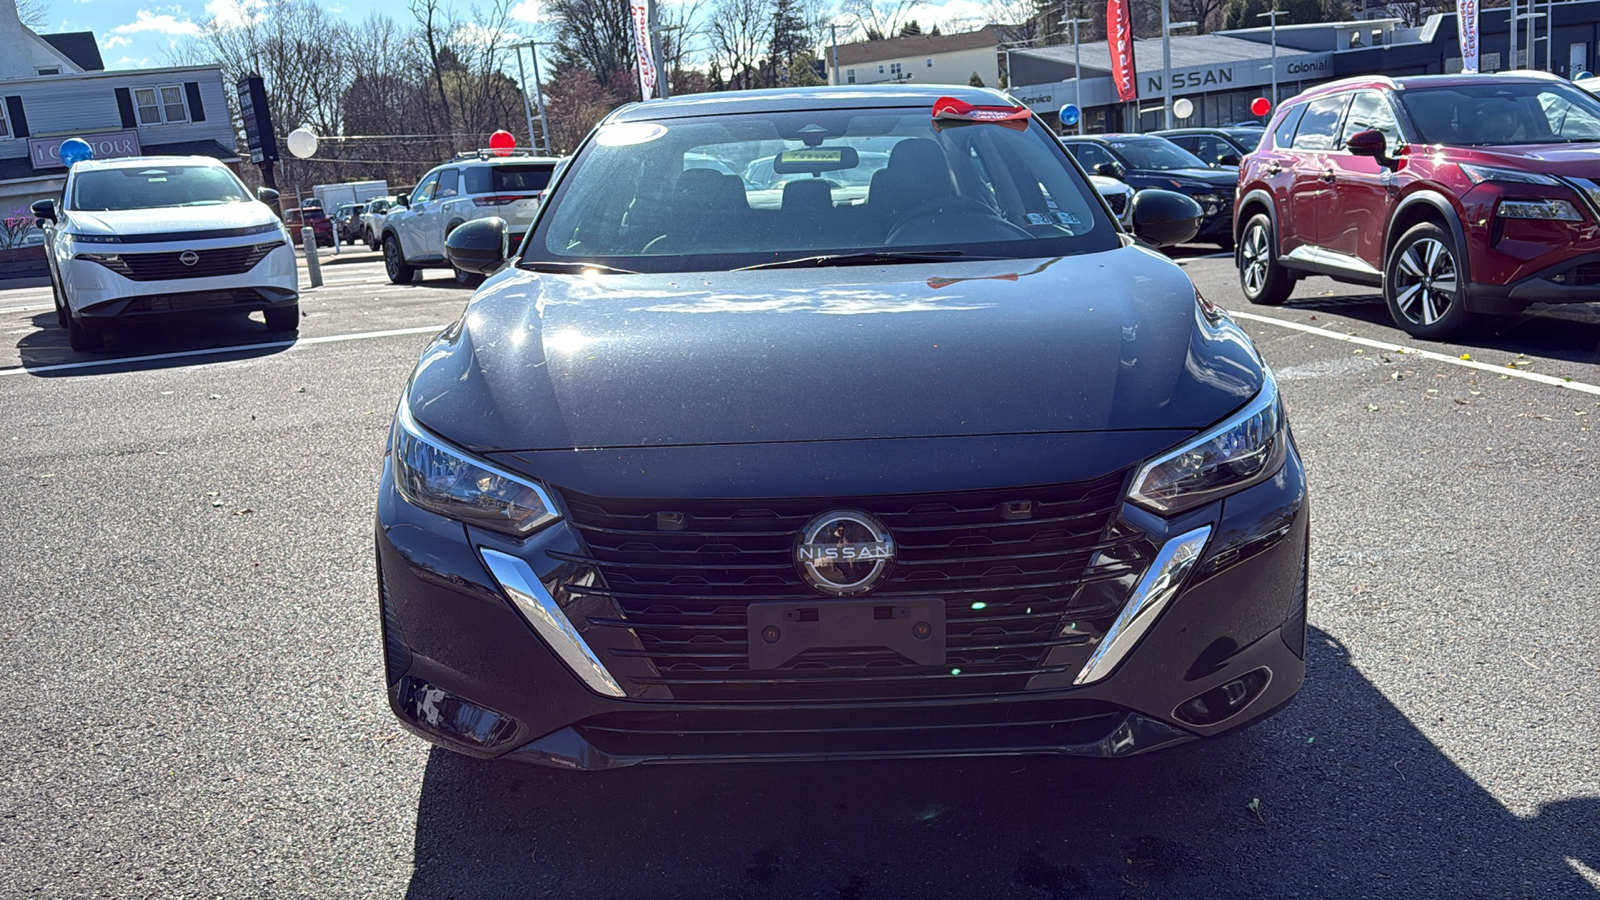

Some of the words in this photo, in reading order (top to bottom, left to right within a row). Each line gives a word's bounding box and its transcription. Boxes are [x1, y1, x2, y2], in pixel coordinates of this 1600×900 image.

[1287, 60, 1327, 74] Colonial
[1148, 68, 1233, 92] NSSAN
[1021, 94, 1052, 105] Service
[48, 139, 133, 160] CTOUR
[799, 545, 890, 560] NISSAN
